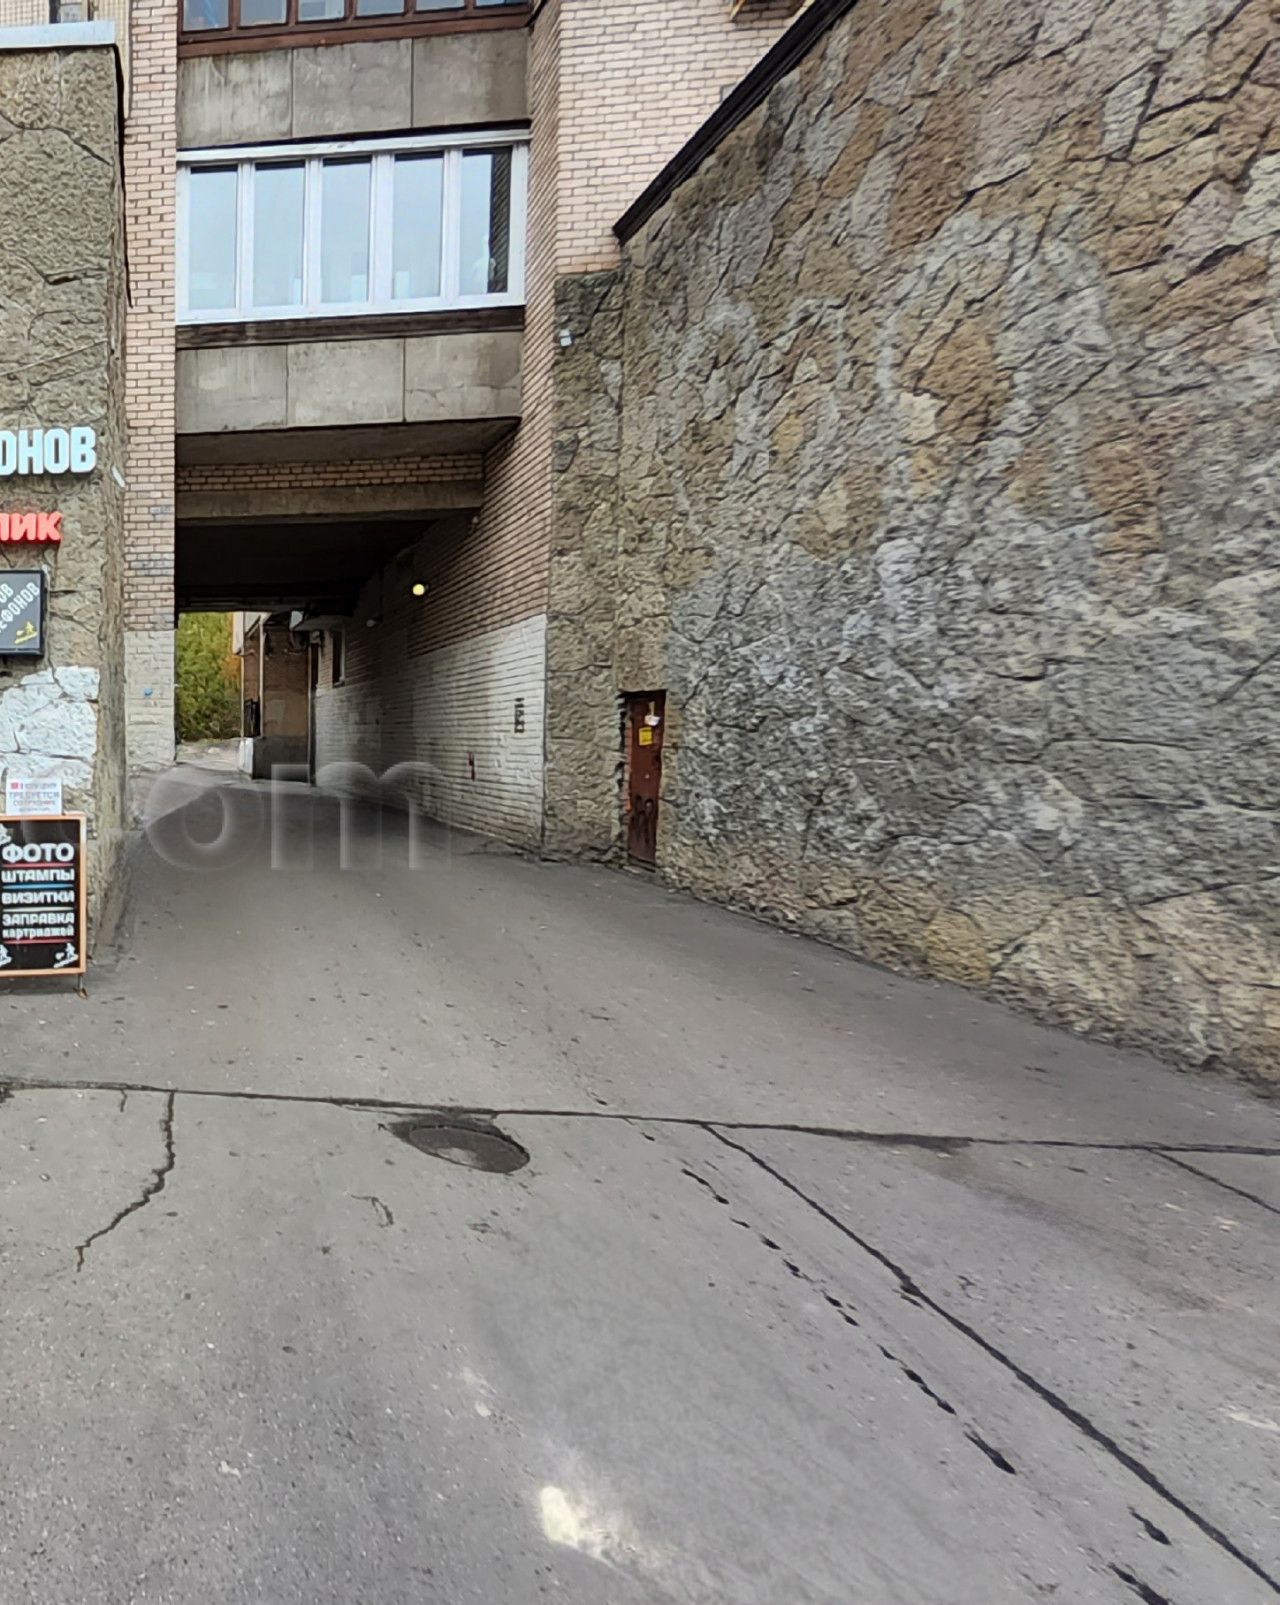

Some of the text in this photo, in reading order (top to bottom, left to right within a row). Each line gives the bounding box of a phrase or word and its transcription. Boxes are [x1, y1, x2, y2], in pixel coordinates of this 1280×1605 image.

[1, 843, 75, 863] ФОТО
[1, 868, 75, 884] ШТАМПЫ
[1, 890, 75, 905] ВИЗИТКИ
[2, 913, 75, 927] ЗАПРАВКА
